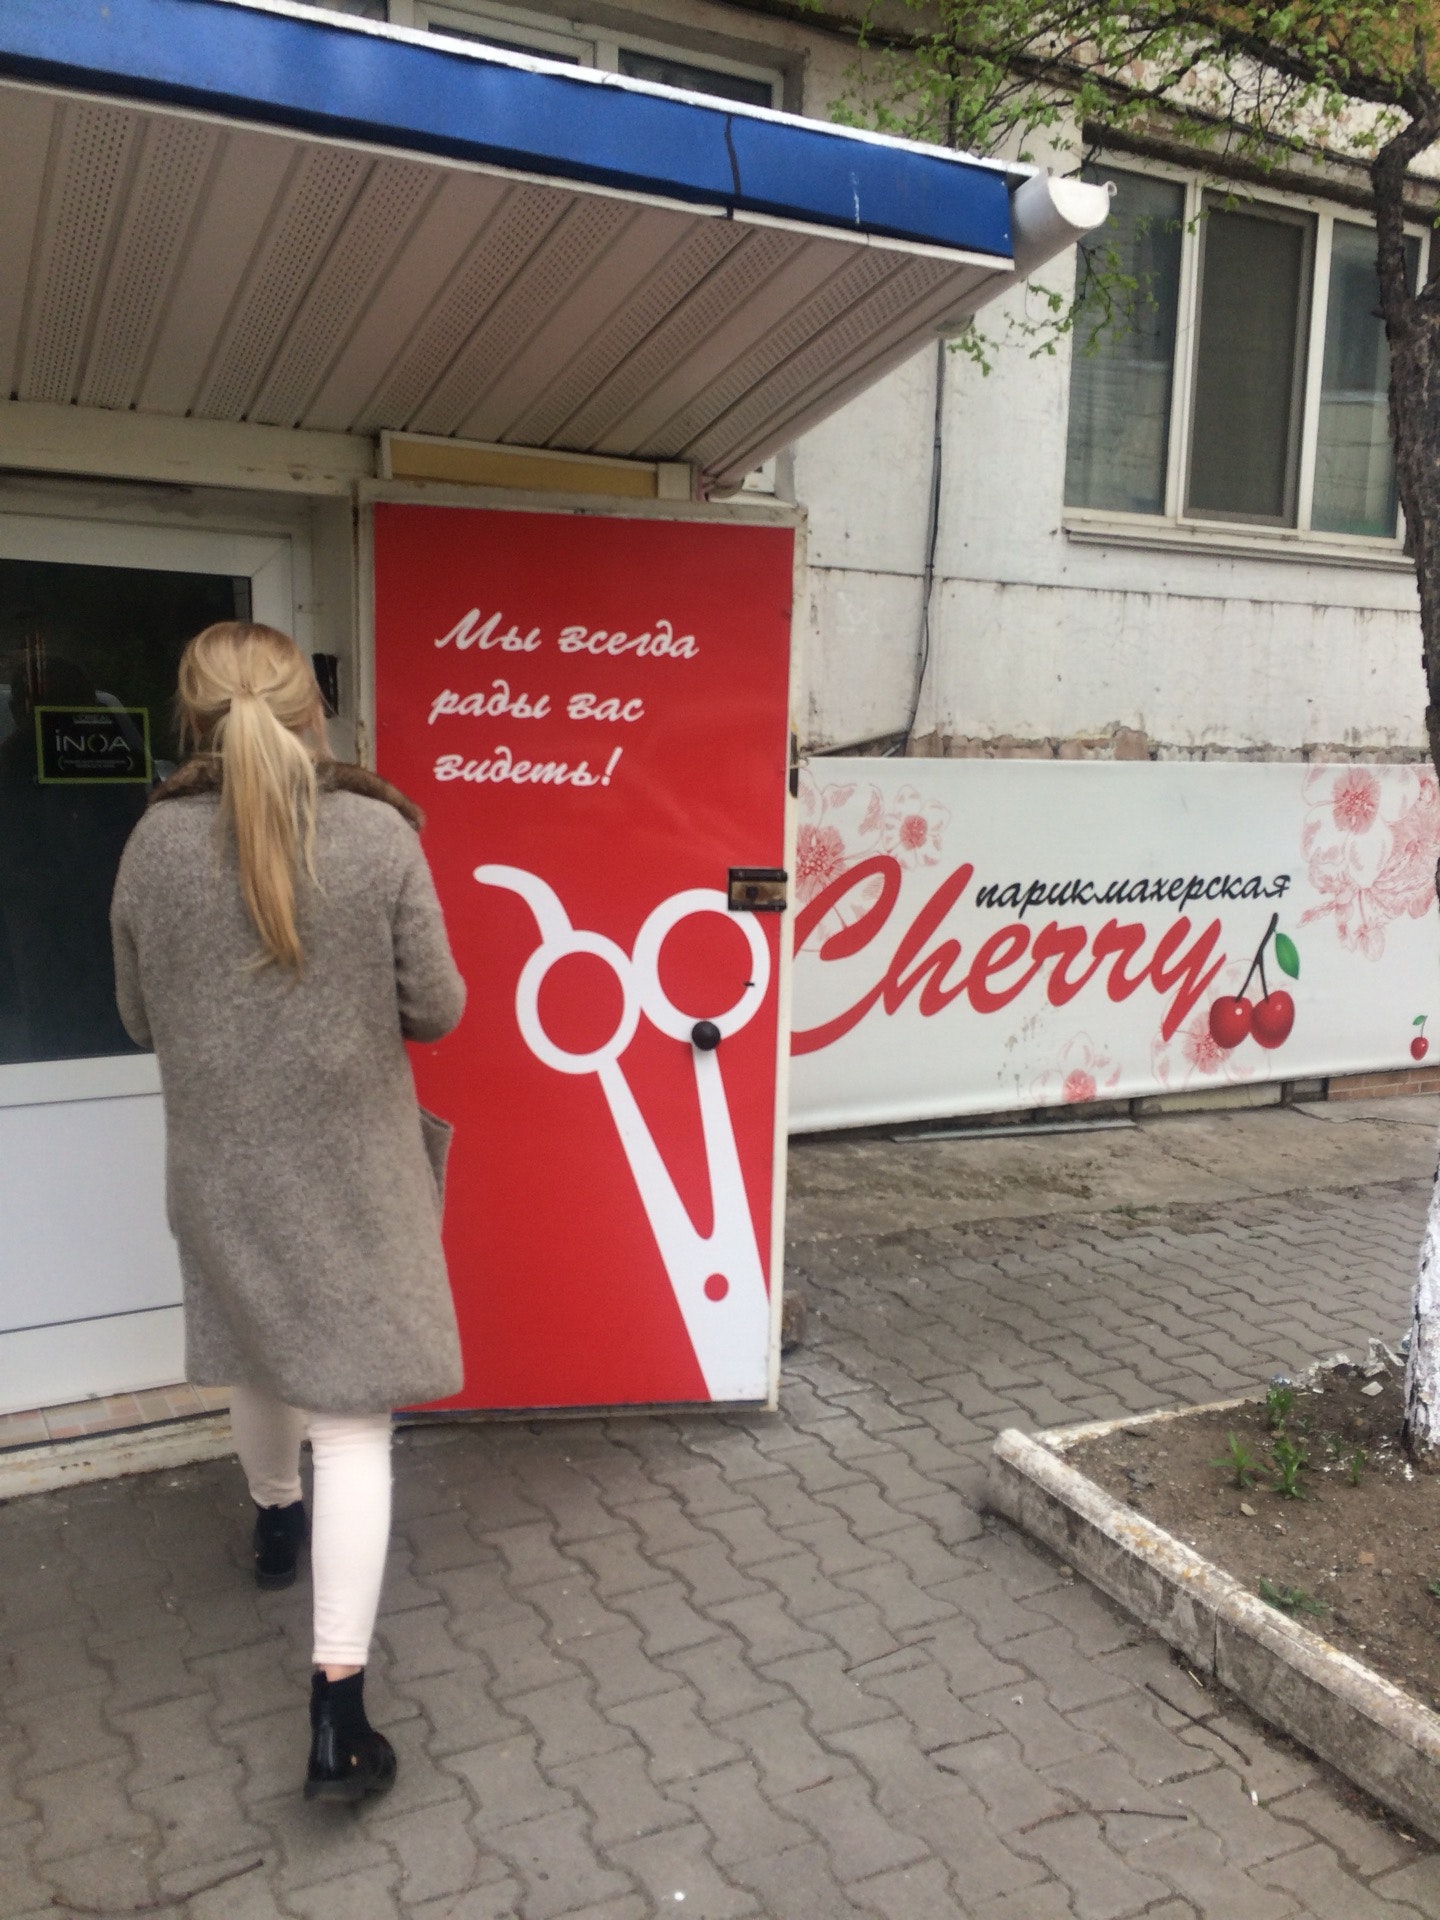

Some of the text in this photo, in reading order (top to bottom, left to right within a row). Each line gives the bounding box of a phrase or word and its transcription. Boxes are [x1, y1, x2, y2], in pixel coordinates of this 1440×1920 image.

[434, 607, 700, 660] Мы всегда
[427, 678, 645, 726] рады вас
[433, 745, 623, 787] видеть!
[975, 872, 1292, 918] парикмахерская
[790, 854, 1227, 1056] Cherry
